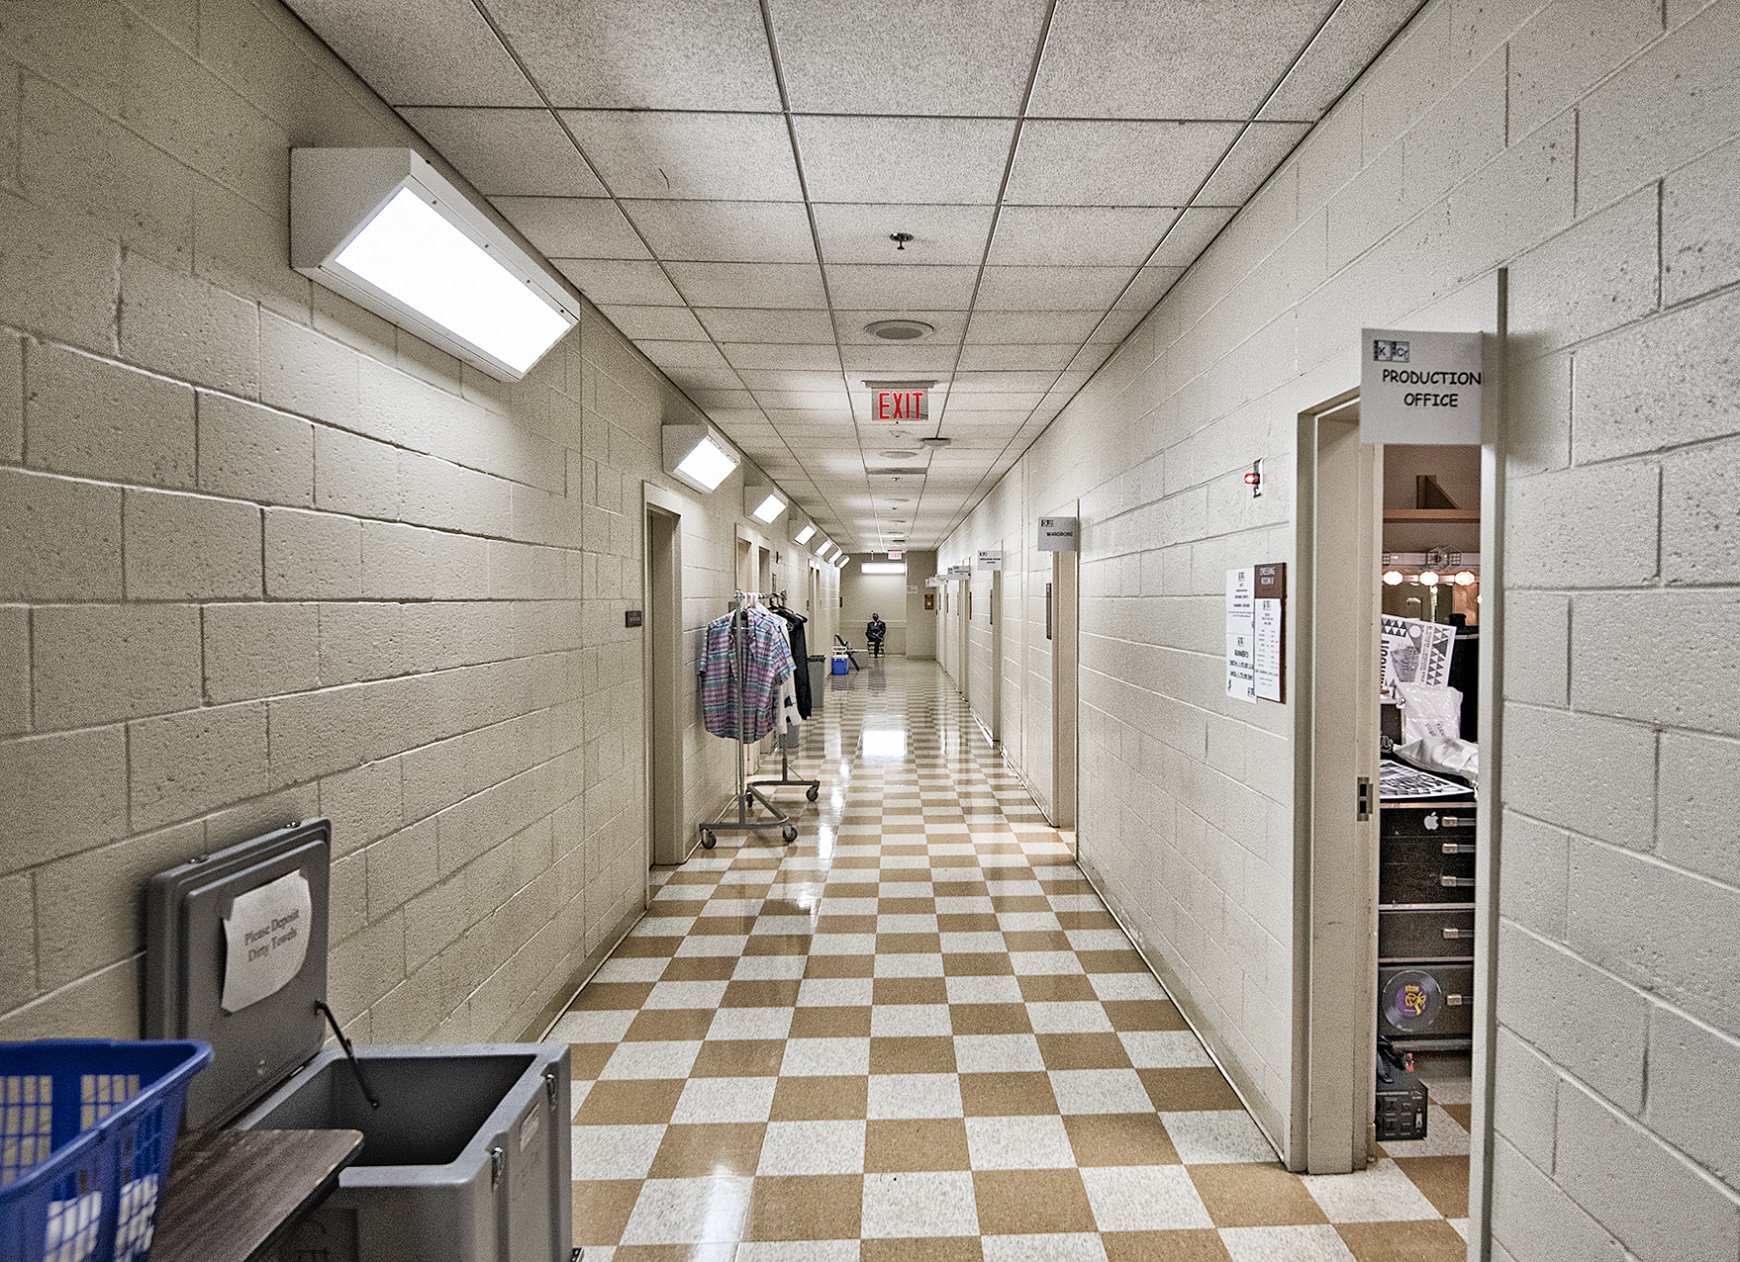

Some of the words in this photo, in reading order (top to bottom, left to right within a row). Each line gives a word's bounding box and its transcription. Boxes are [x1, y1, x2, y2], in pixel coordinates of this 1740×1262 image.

[1383, 369, 1482, 385] PRODUCTION
[879, 392, 923, 420] EXIT
[1404, 393, 1459, 407] OFFICE
[244, 926, 270, 946] Please
[271, 910, 300, 931] Deposit
[248, 944, 270, 962] Dirty
[271, 927, 298, 949] Towels
